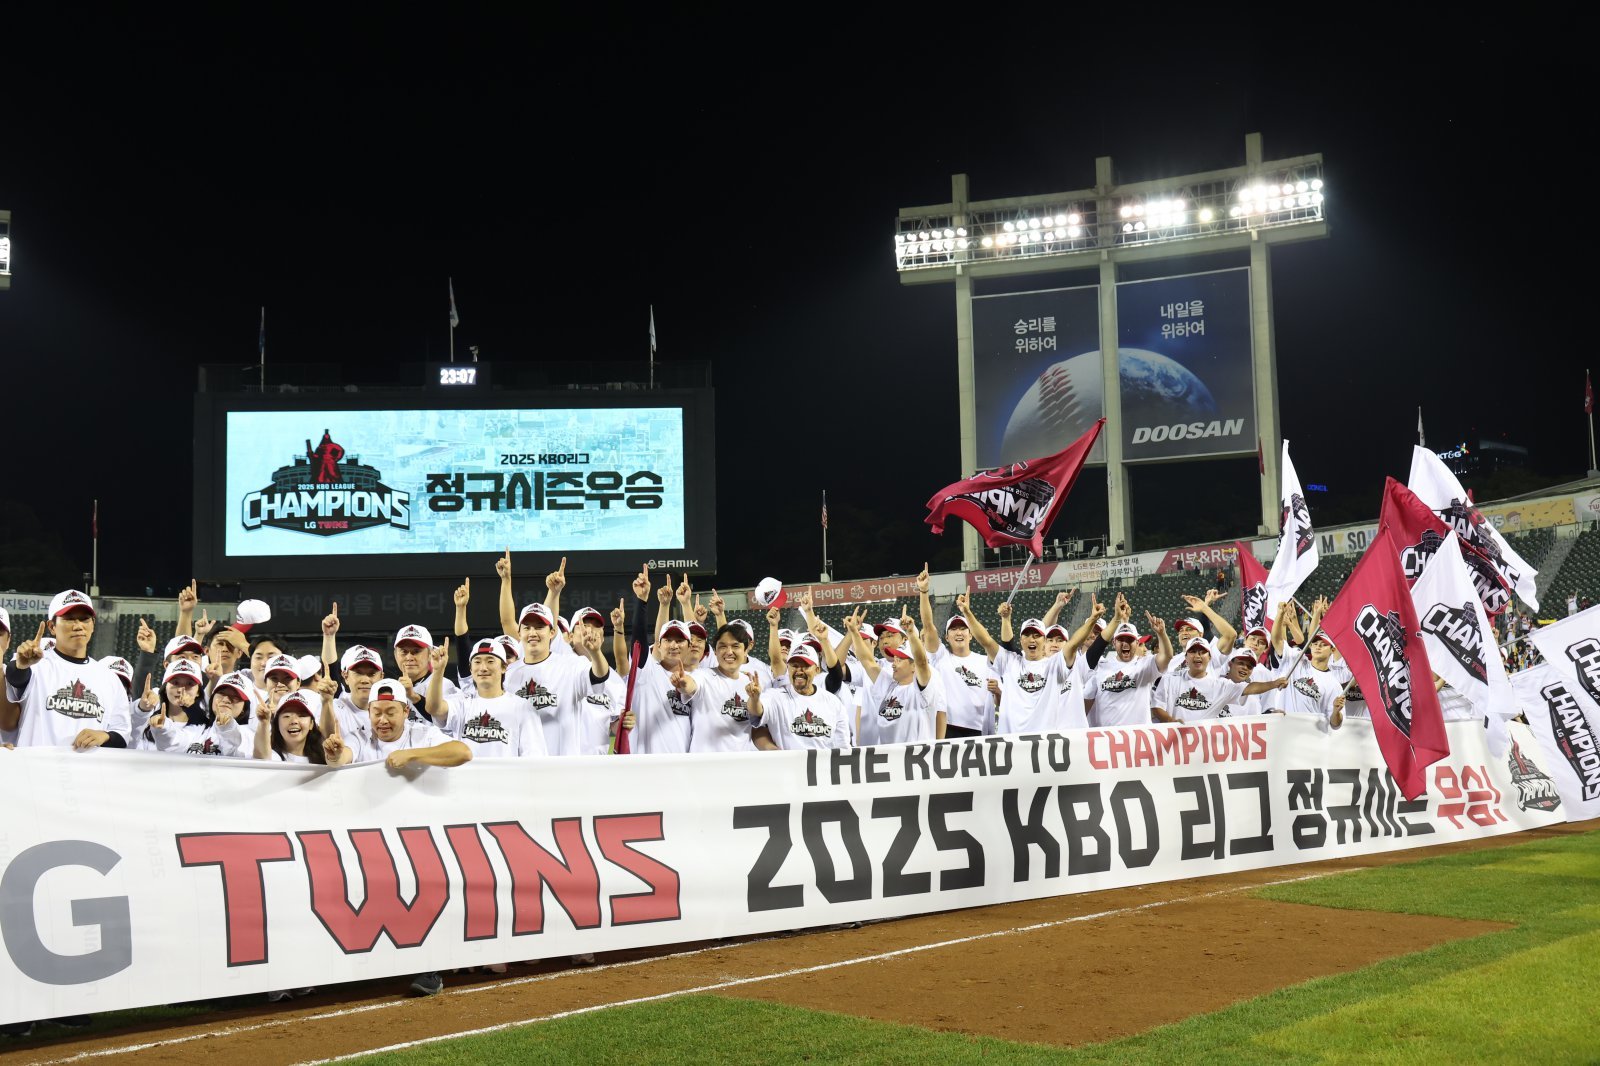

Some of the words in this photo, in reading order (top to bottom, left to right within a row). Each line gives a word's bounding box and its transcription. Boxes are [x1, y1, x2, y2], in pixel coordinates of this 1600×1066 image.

[1160, 300, 1204, 320] 내일을
[1013, 316, 1057, 335] 승리를
[1161, 320, 1205, 339] 위하여
[1015, 335, 1057, 353] 위하여
[440, 368, 476, 384] 23:07
[1131, 418, 1245, 444] DOOSAN
[500, 453, 535, 465] 2025
[538, 453, 590, 465] KBO리그
[426, 470, 665, 512] 정규시즌우승
[242, 490, 410, 527] CHAMPIONS
[304, 521, 317, 529] LG
[657, 559, 699, 568] SAMIK
[974, 567, 1042, 589] 달려라병원
[815, 588, 844, 600] 타이밍
[869, 582, 921, 596] 하이리병
[1461, 653, 1472, 664] LG
[47, 696, 104, 723] CHAMPIONS
[1175, 698, 1212, 709] CHAMPIONS
[1556, 728, 1564, 738] LG
[904, 736, 1013, 781] ROAD
[1019, 733, 1071, 774] TO
[1086, 722, 1267, 770] CHAMPIONS
[175, 811, 681, 968] TWINS
[732, 791, 986, 913] 2025
[1002, 779, 1160, 883] KBO
[1173, 771, 1275, 861] 리그
